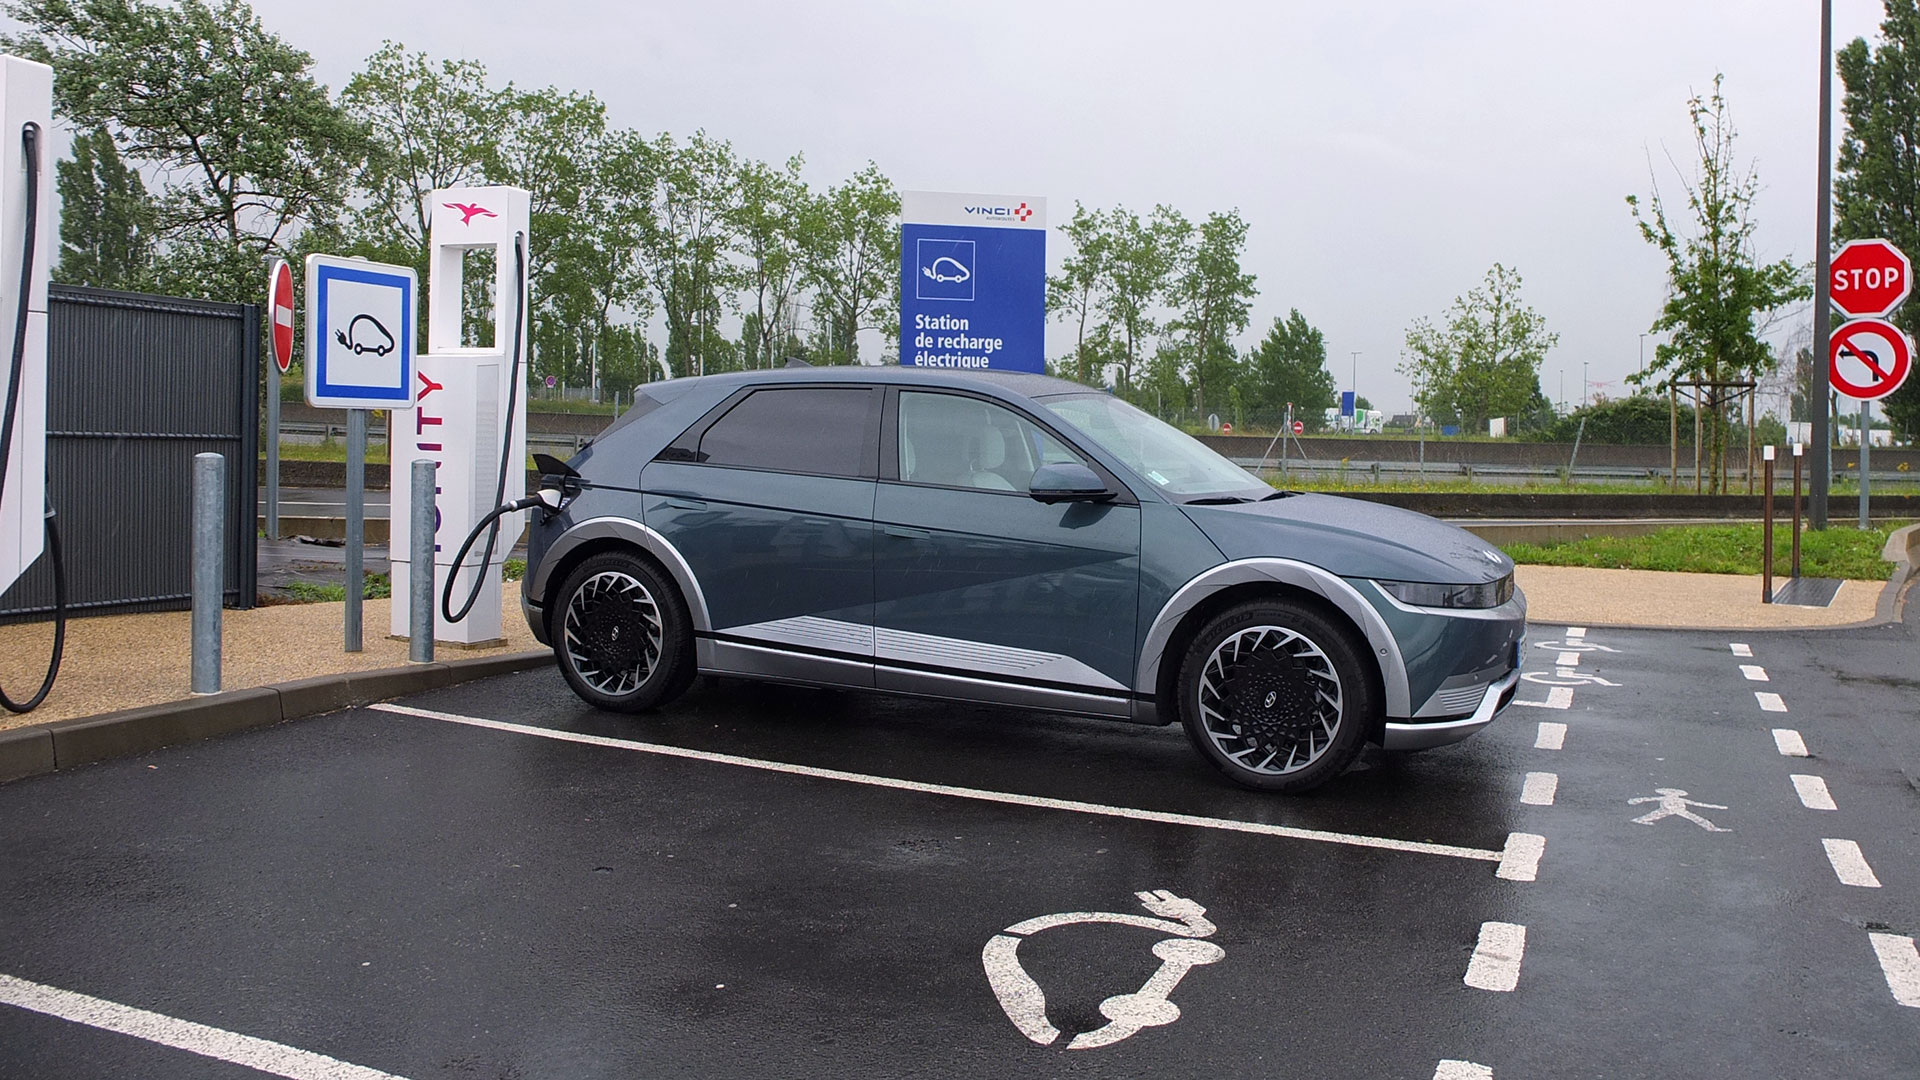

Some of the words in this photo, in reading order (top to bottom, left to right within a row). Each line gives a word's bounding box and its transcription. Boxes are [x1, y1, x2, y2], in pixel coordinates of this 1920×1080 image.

[964, 207, 1010, 215] VINCI
[1834, 267, 1899, 291] STOP
[915, 314, 969, 331] Station
[915, 332, 934, 348] de
[937, 333, 1003, 353] recharge
[915, 351, 989, 368] électrique
